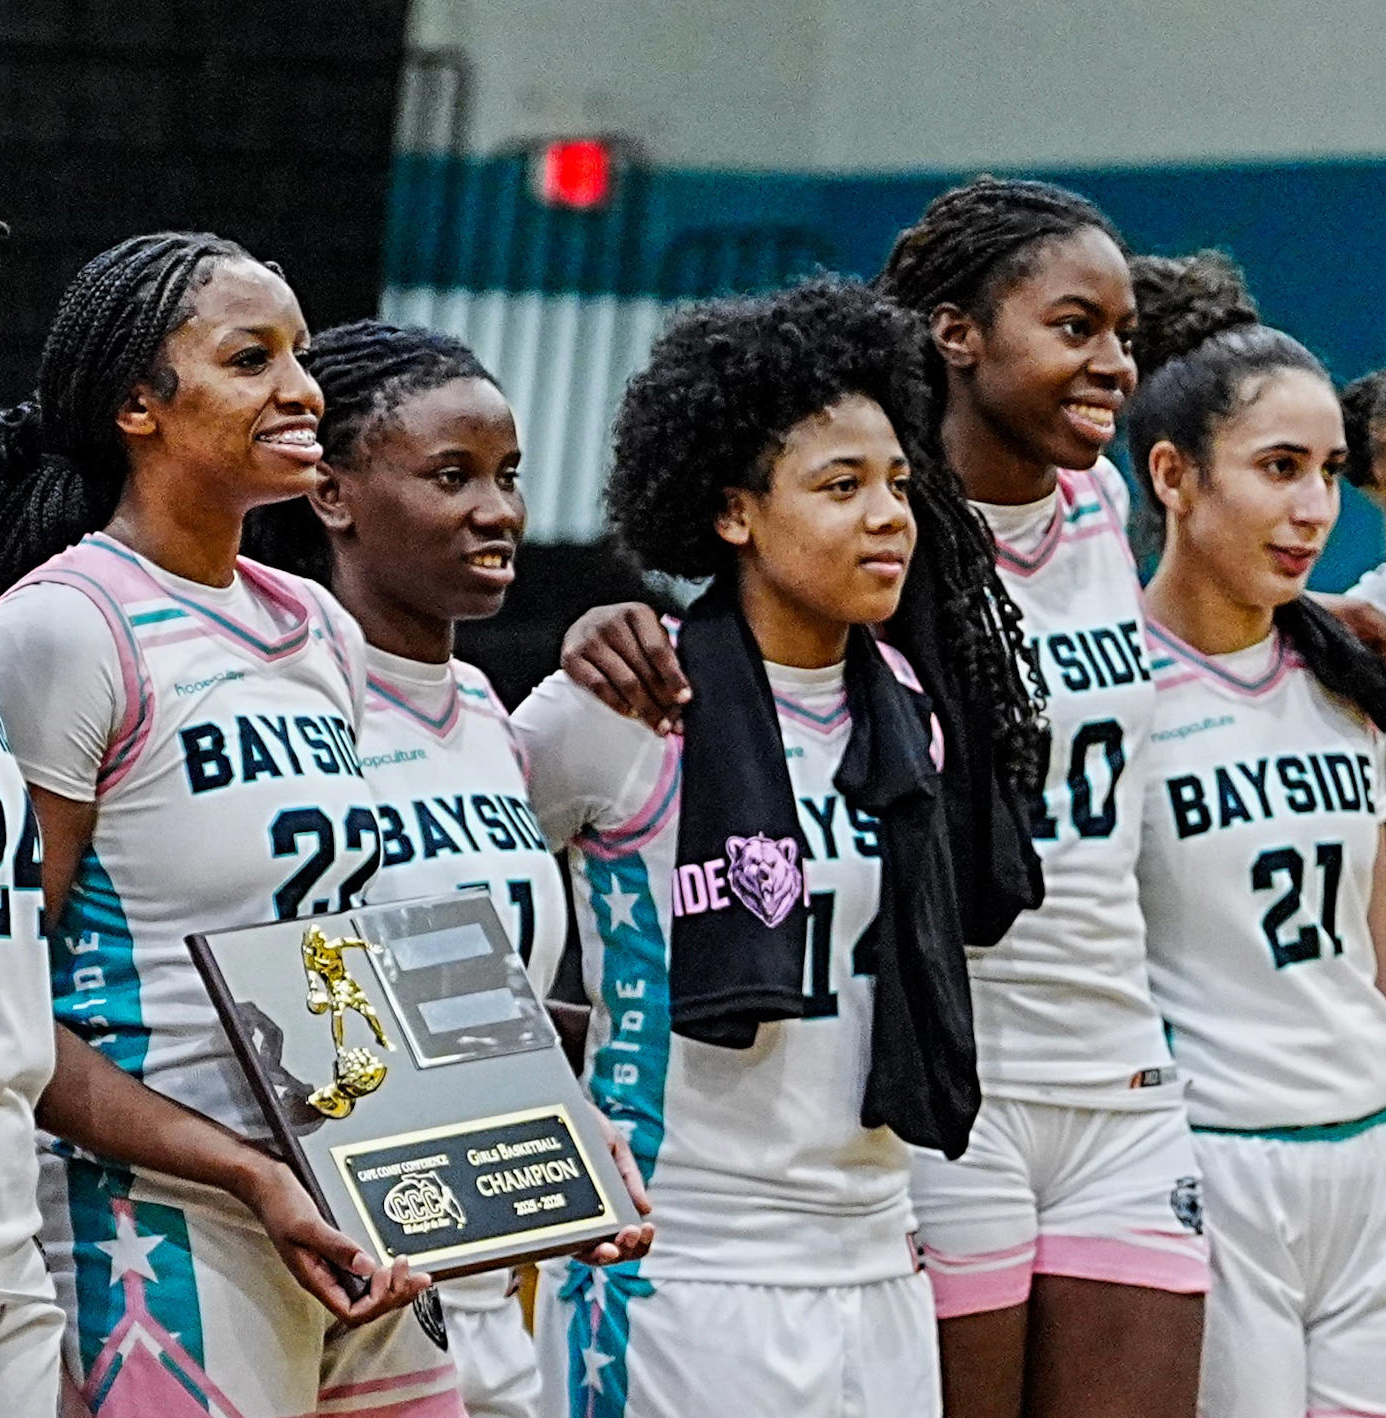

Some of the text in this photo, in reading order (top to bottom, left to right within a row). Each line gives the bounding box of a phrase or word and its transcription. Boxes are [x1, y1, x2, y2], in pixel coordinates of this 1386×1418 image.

[178, 714, 364, 795] BAYSID
[358, 748, 428, 769] oopculture
[376, 795, 548, 868] BAYSID
[1251, 843, 1344, 971] 21
[391, 1187, 445, 1223] CCC
[475, 1157, 580, 1198] CHAMPION
